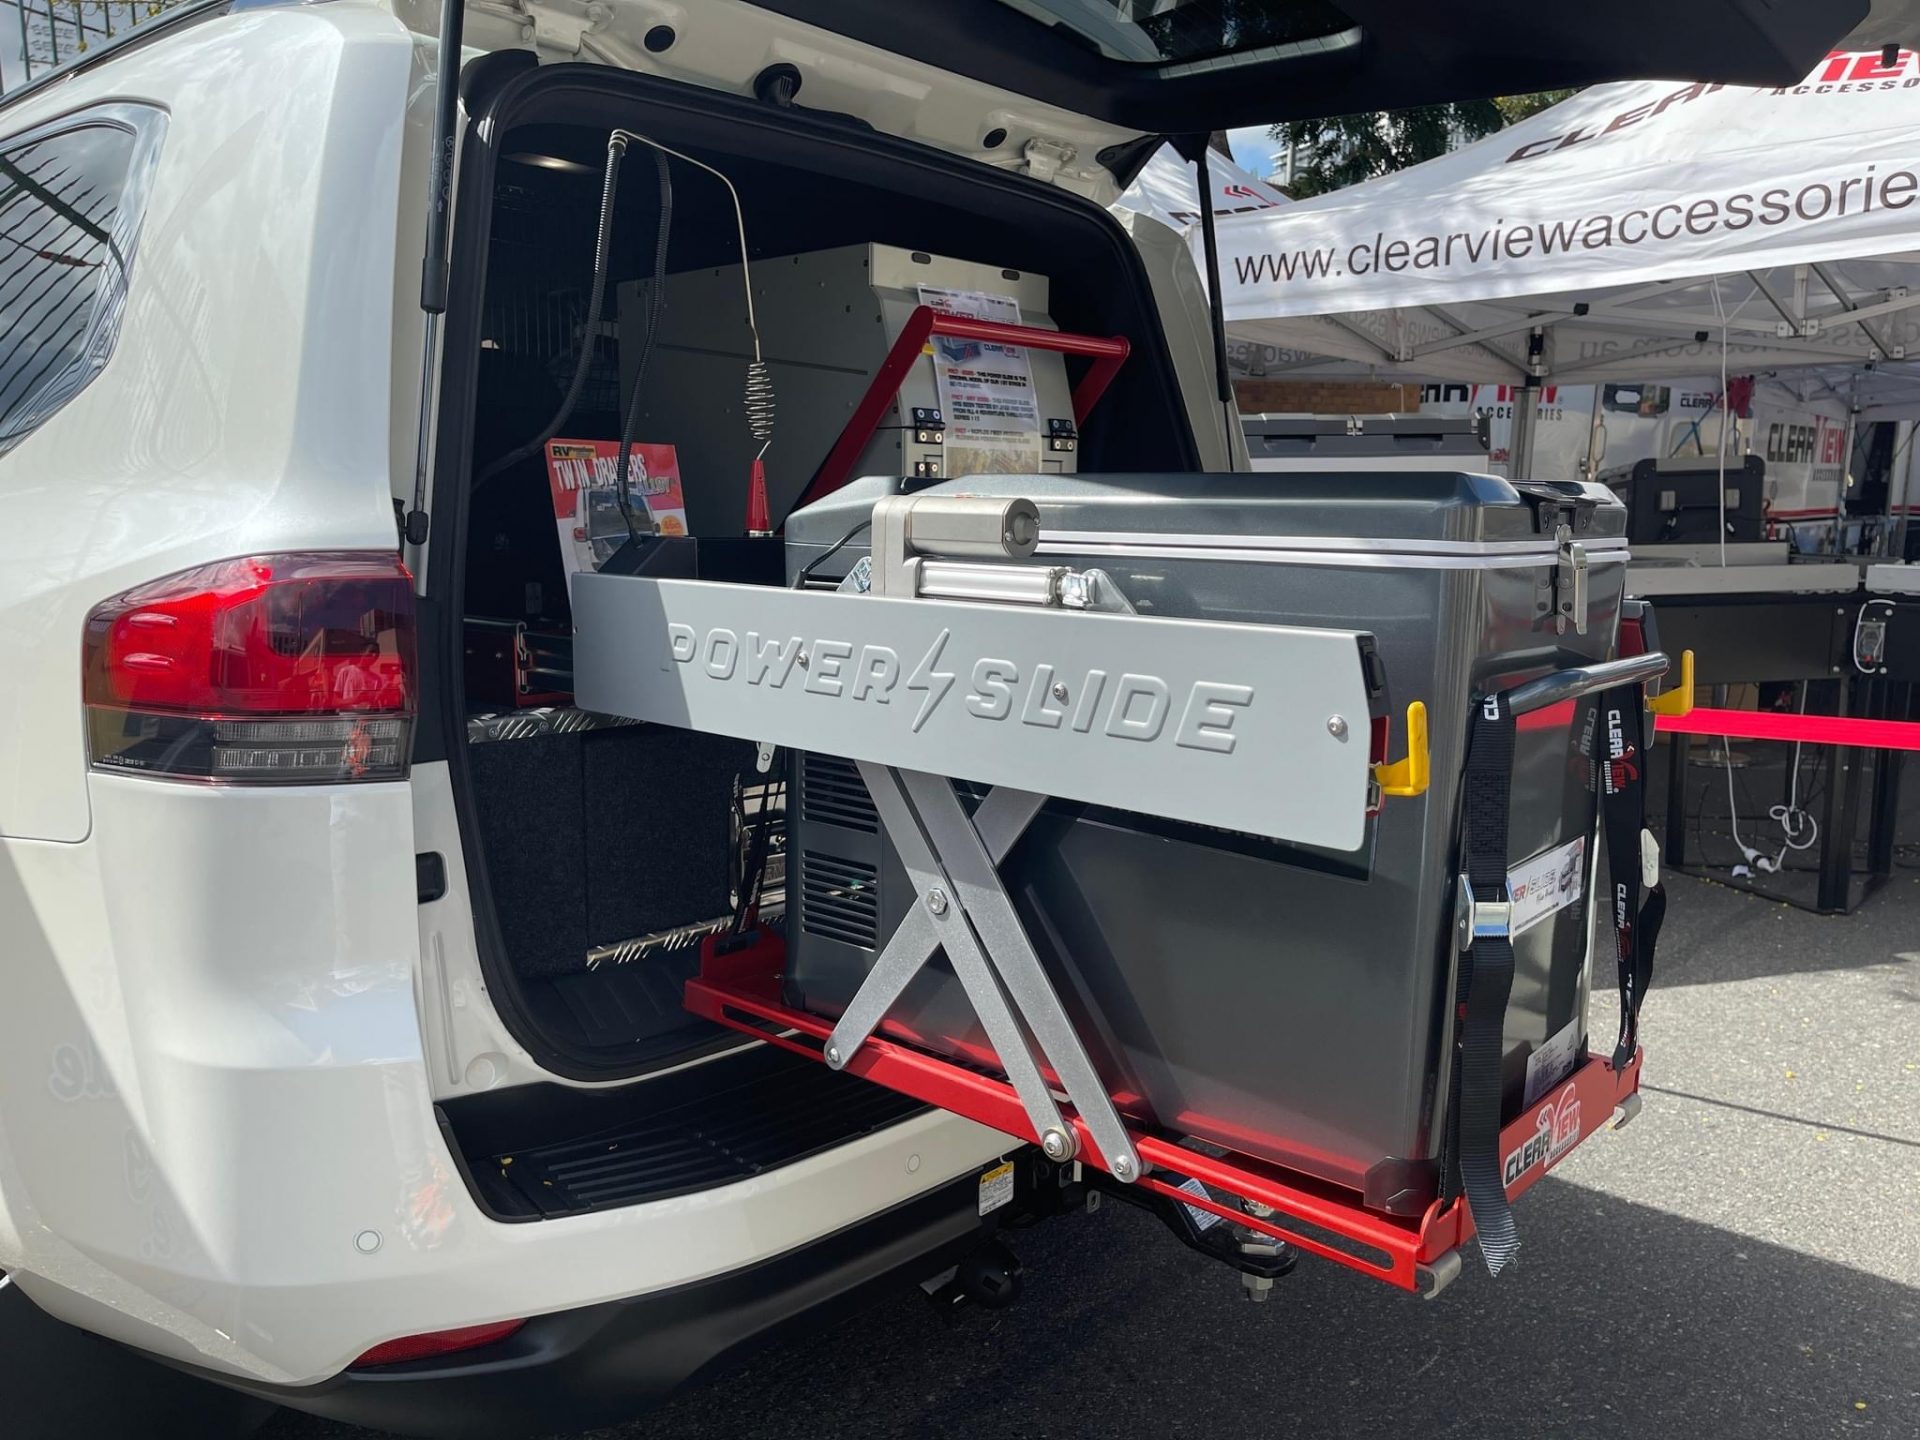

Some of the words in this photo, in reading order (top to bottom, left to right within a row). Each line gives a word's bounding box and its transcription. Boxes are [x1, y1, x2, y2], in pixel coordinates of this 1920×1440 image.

[553, 458, 591, 493] TWIN
[591, 454, 648, 487] DRAERS
[661, 623, 900, 703] POWER
[966, 658, 1254, 754] SLIDE
[1505, 1083, 1580, 1186] CLEARVIEW
